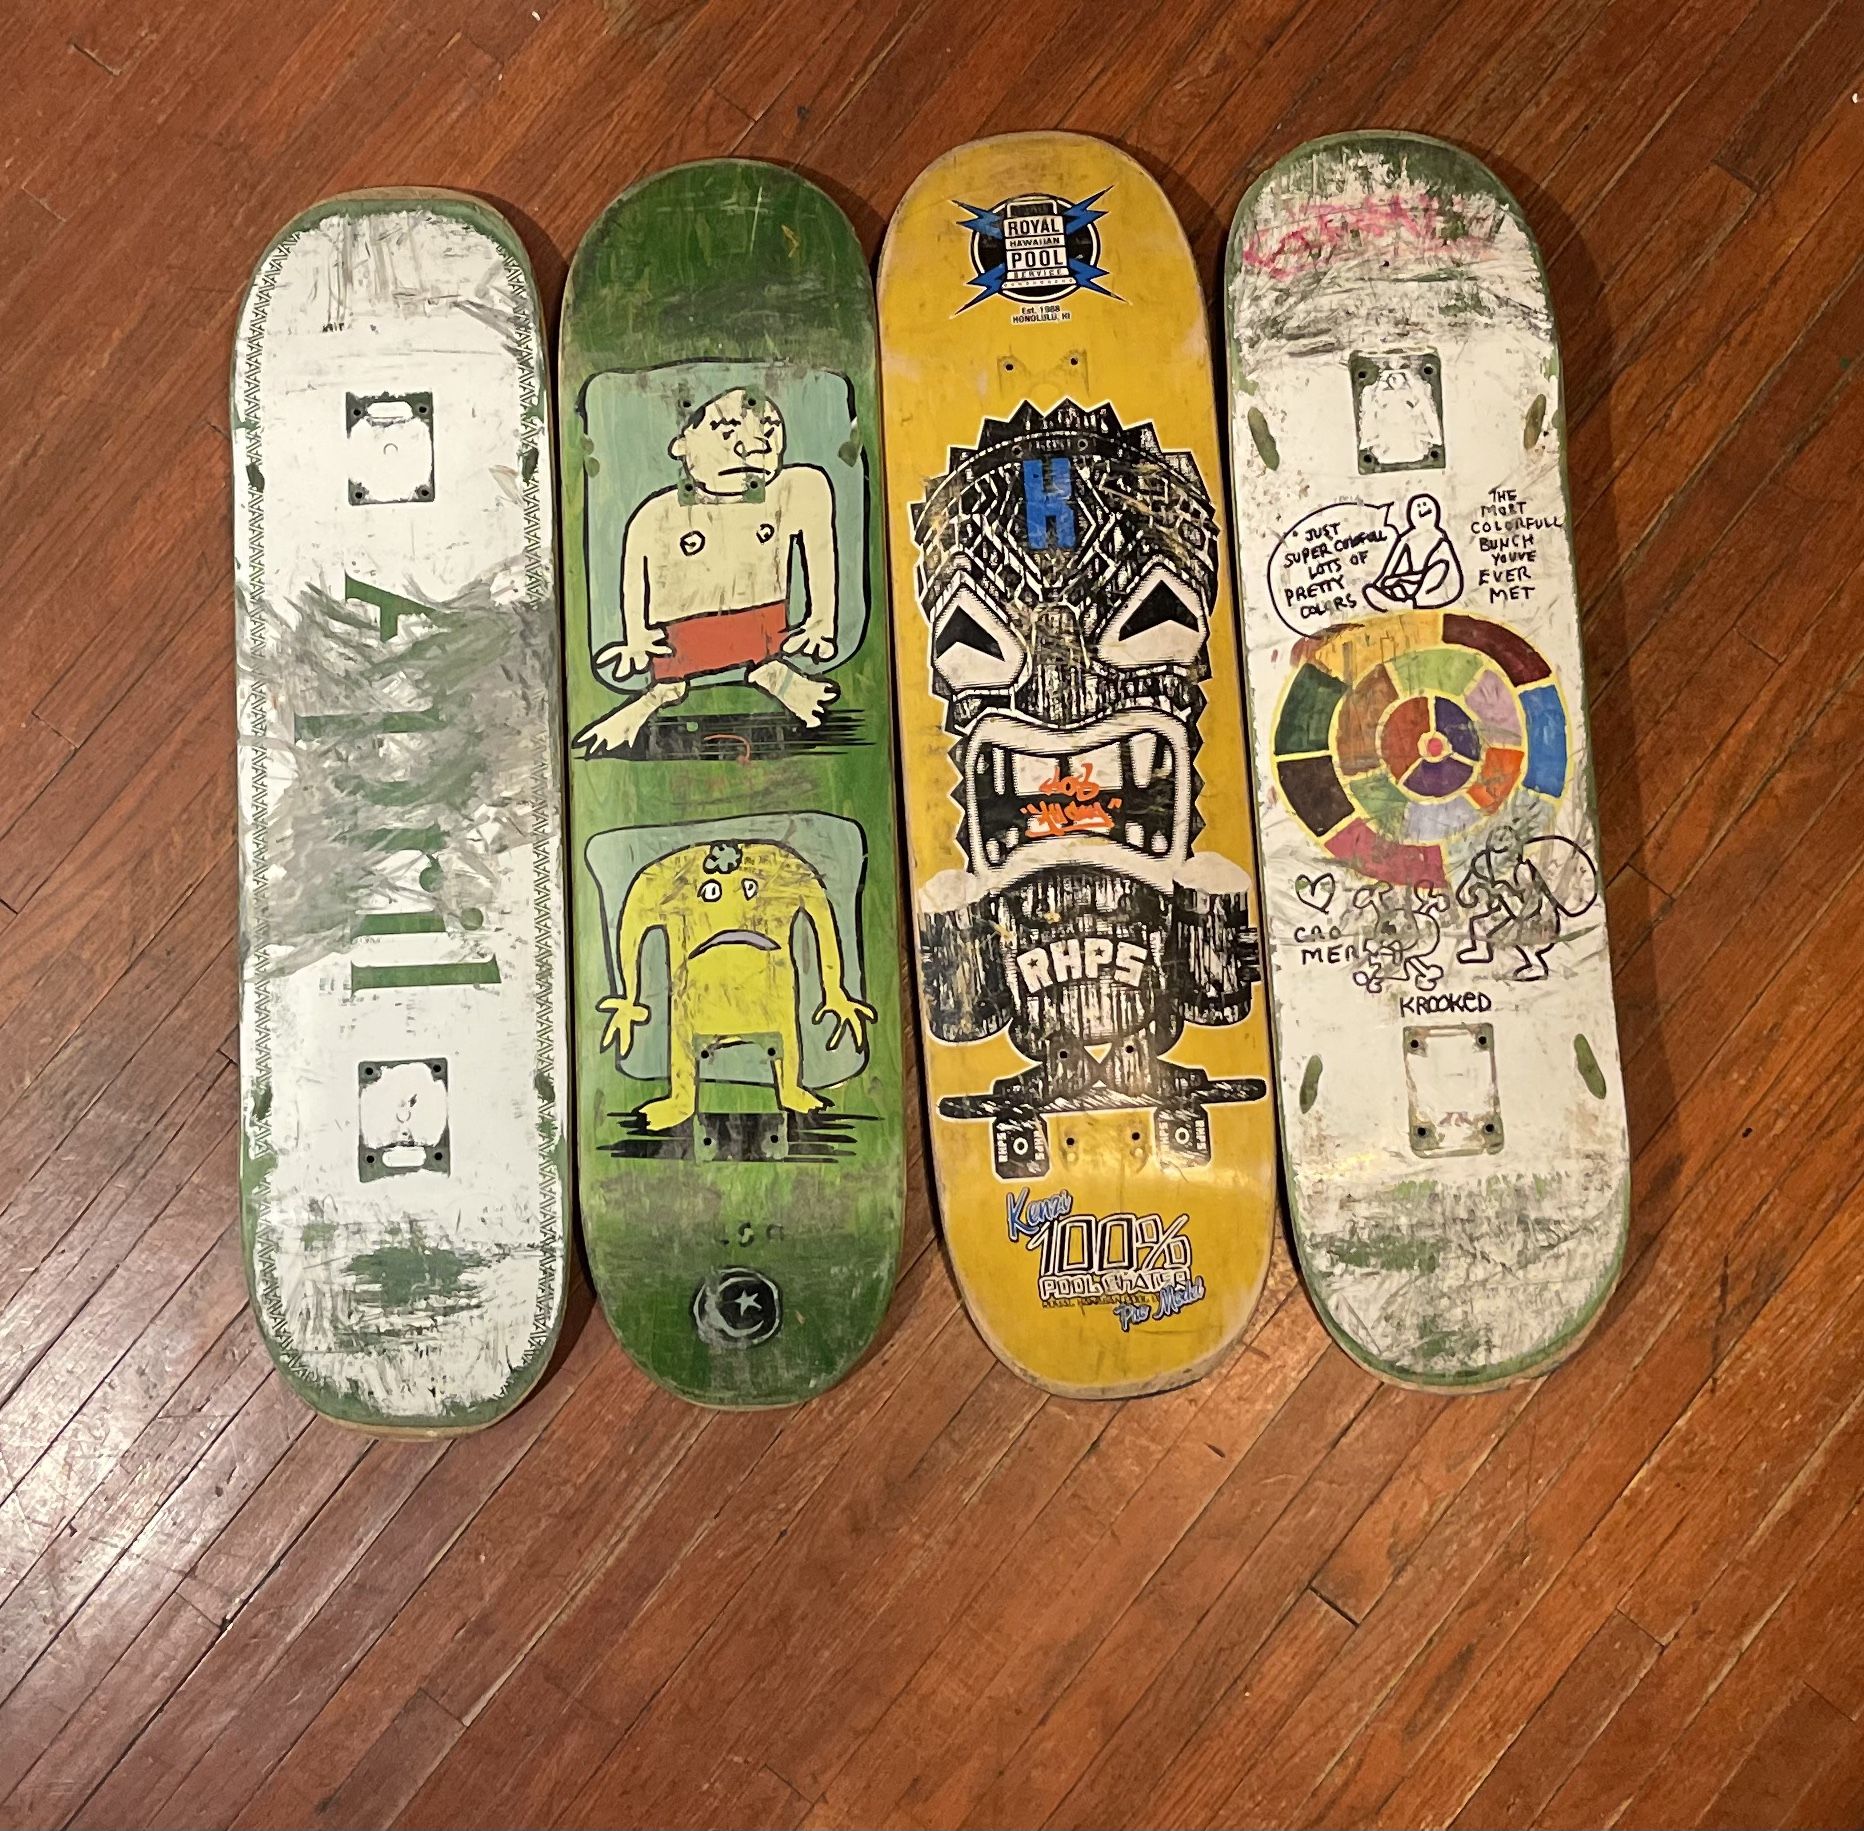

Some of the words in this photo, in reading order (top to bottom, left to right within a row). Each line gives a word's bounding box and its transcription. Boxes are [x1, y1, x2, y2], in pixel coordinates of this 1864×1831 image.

[1008, 218, 1060, 236] ROYAL
[1009, 237, 1060, 248] HAWAIIAN
[1011, 249, 1064, 269] POOL
[1487, 487, 1517, 503] THE
[1305, 522, 1341, 542] JUST
[1470, 516, 1563, 534] COLORFULL
[1479, 533, 1534, 552] BUNCH
[1283, 542, 1333, 569] SUPER
[1308, 558, 1341, 580] LOTS
[1350, 550, 1369, 566] OF
[1491, 549, 1537, 566] YOUVE
[1478, 566, 1531, 586] EVER
[1284, 574, 1344, 607] PRETTY
[1489, 586, 1536, 604] MET
[1300, 593, 1357, 619] COLORS
[1017, 937, 1148, 994] RHPS
[1026, 1212, 1193, 1277] 100%
[1038, 1275, 1104, 1301] POOL
